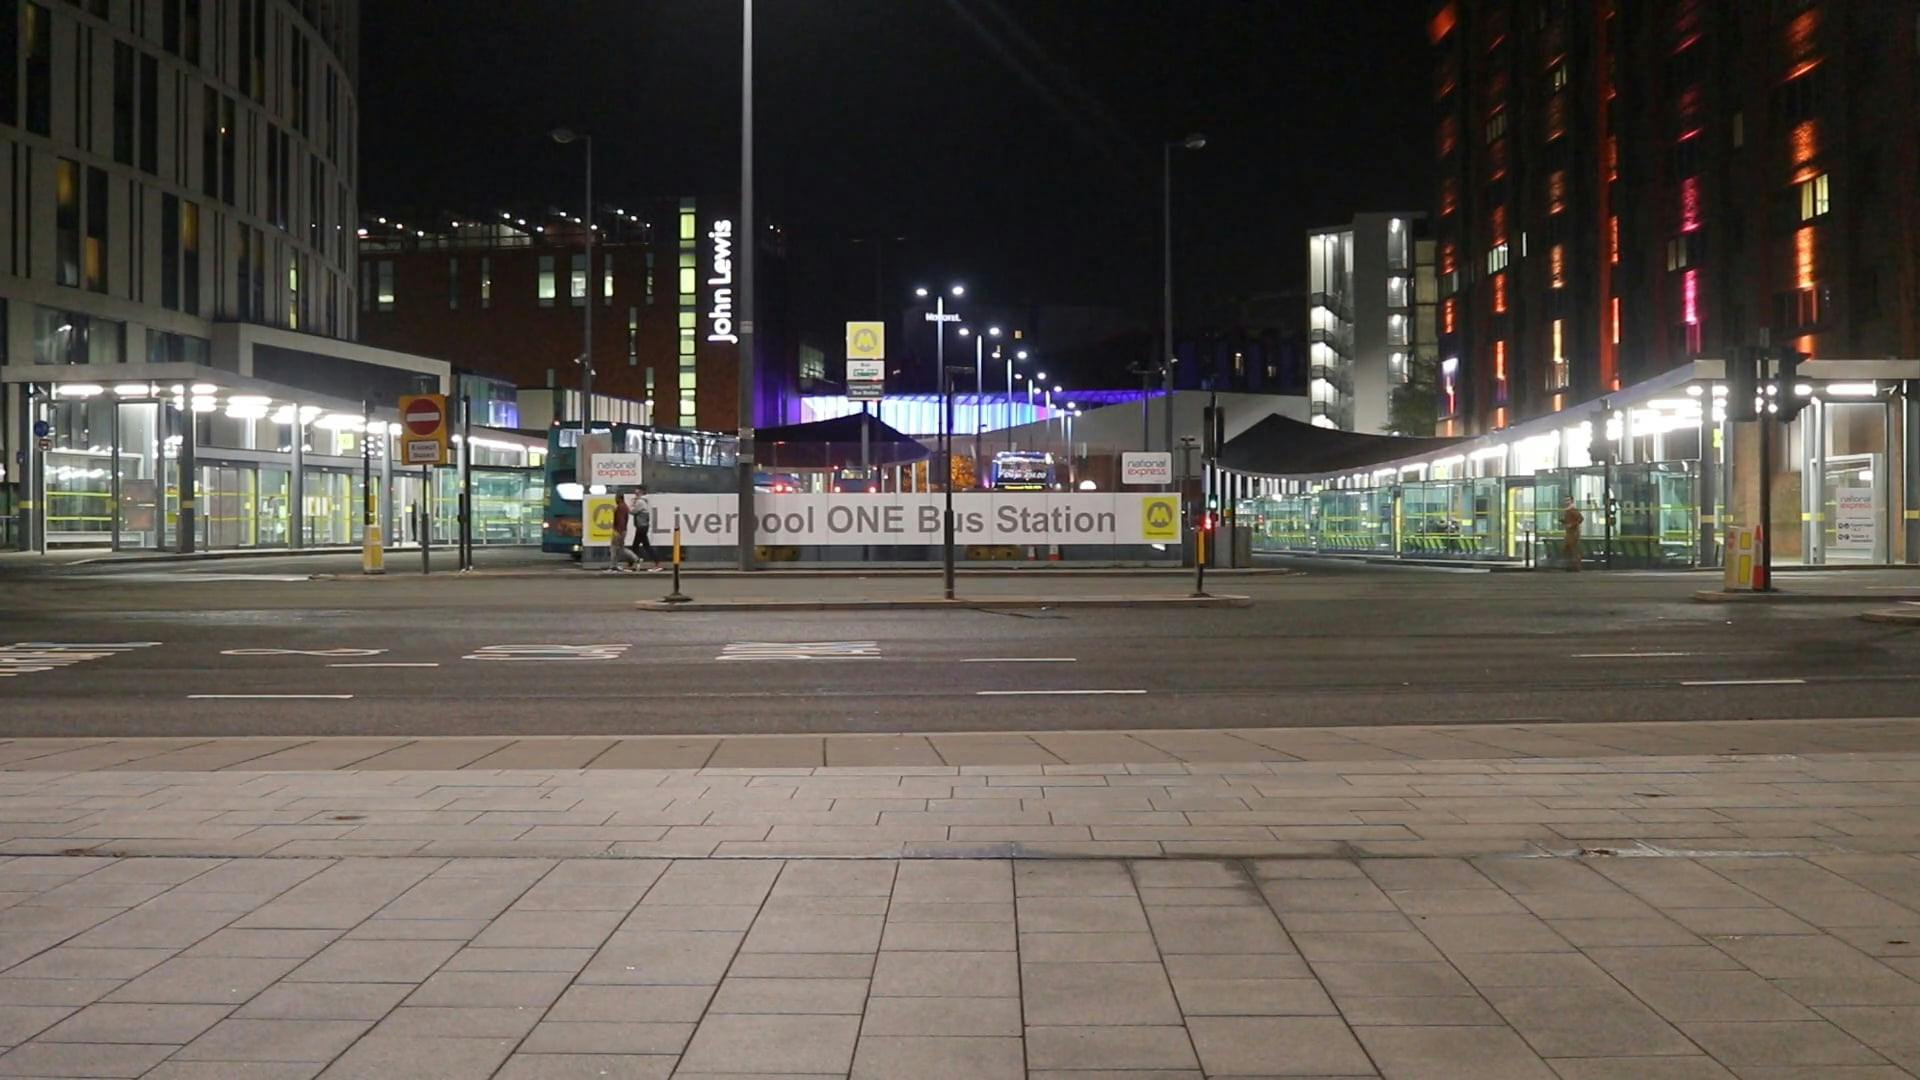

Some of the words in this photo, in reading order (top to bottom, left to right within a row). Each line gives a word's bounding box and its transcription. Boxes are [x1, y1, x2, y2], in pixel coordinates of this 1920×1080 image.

[707, 219, 732, 285] Lewis
[707, 288, 739, 344] John
[597, 459, 637, 469] national
[1127, 459, 1166, 468] national
[597, 468, 637, 478] express
[1127, 467, 1167, 477] express
[827, 505, 904, 534] ONE
[997, 504, 1116, 533] Station
[715, 641, 882, 661] PARK
